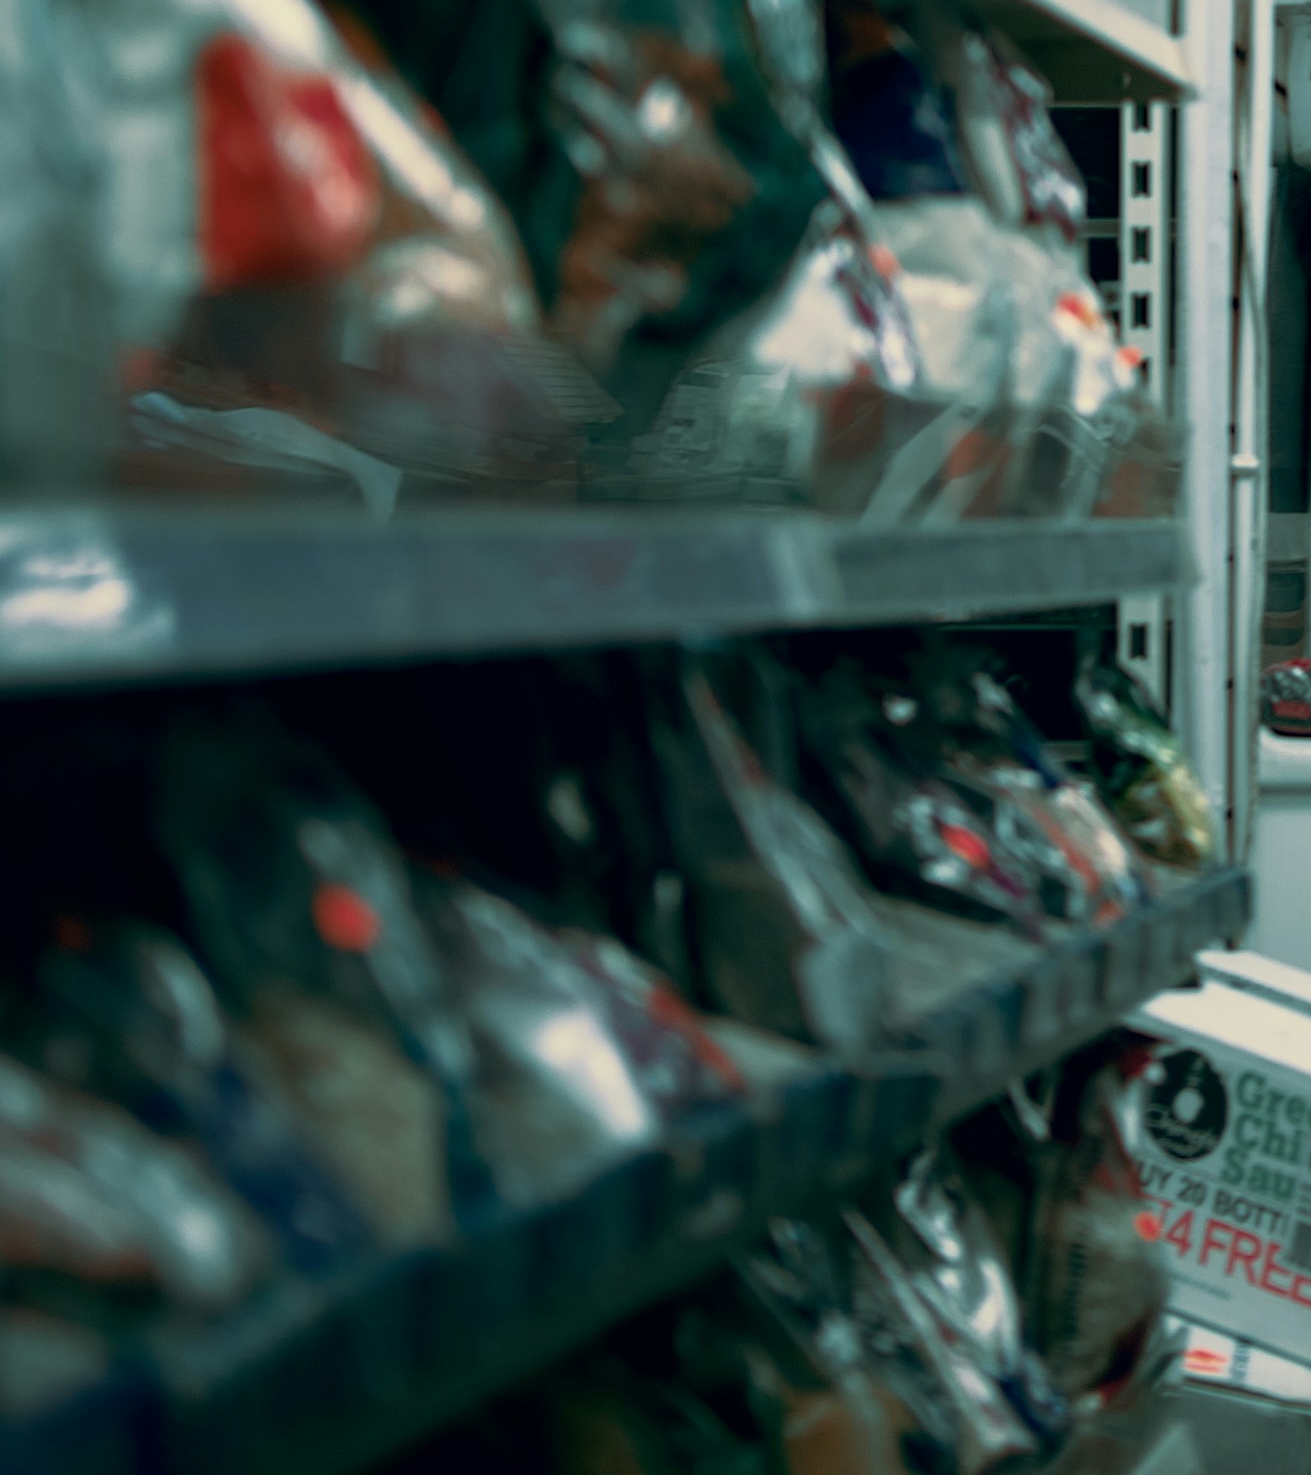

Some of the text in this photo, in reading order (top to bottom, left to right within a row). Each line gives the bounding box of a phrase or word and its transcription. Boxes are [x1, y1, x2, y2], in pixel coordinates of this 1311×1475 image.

[1235, 1112, 1302, 1166] Chi
[1137, 1160, 1173, 1193] UY
[1222, 1146, 1297, 1200] Sau
